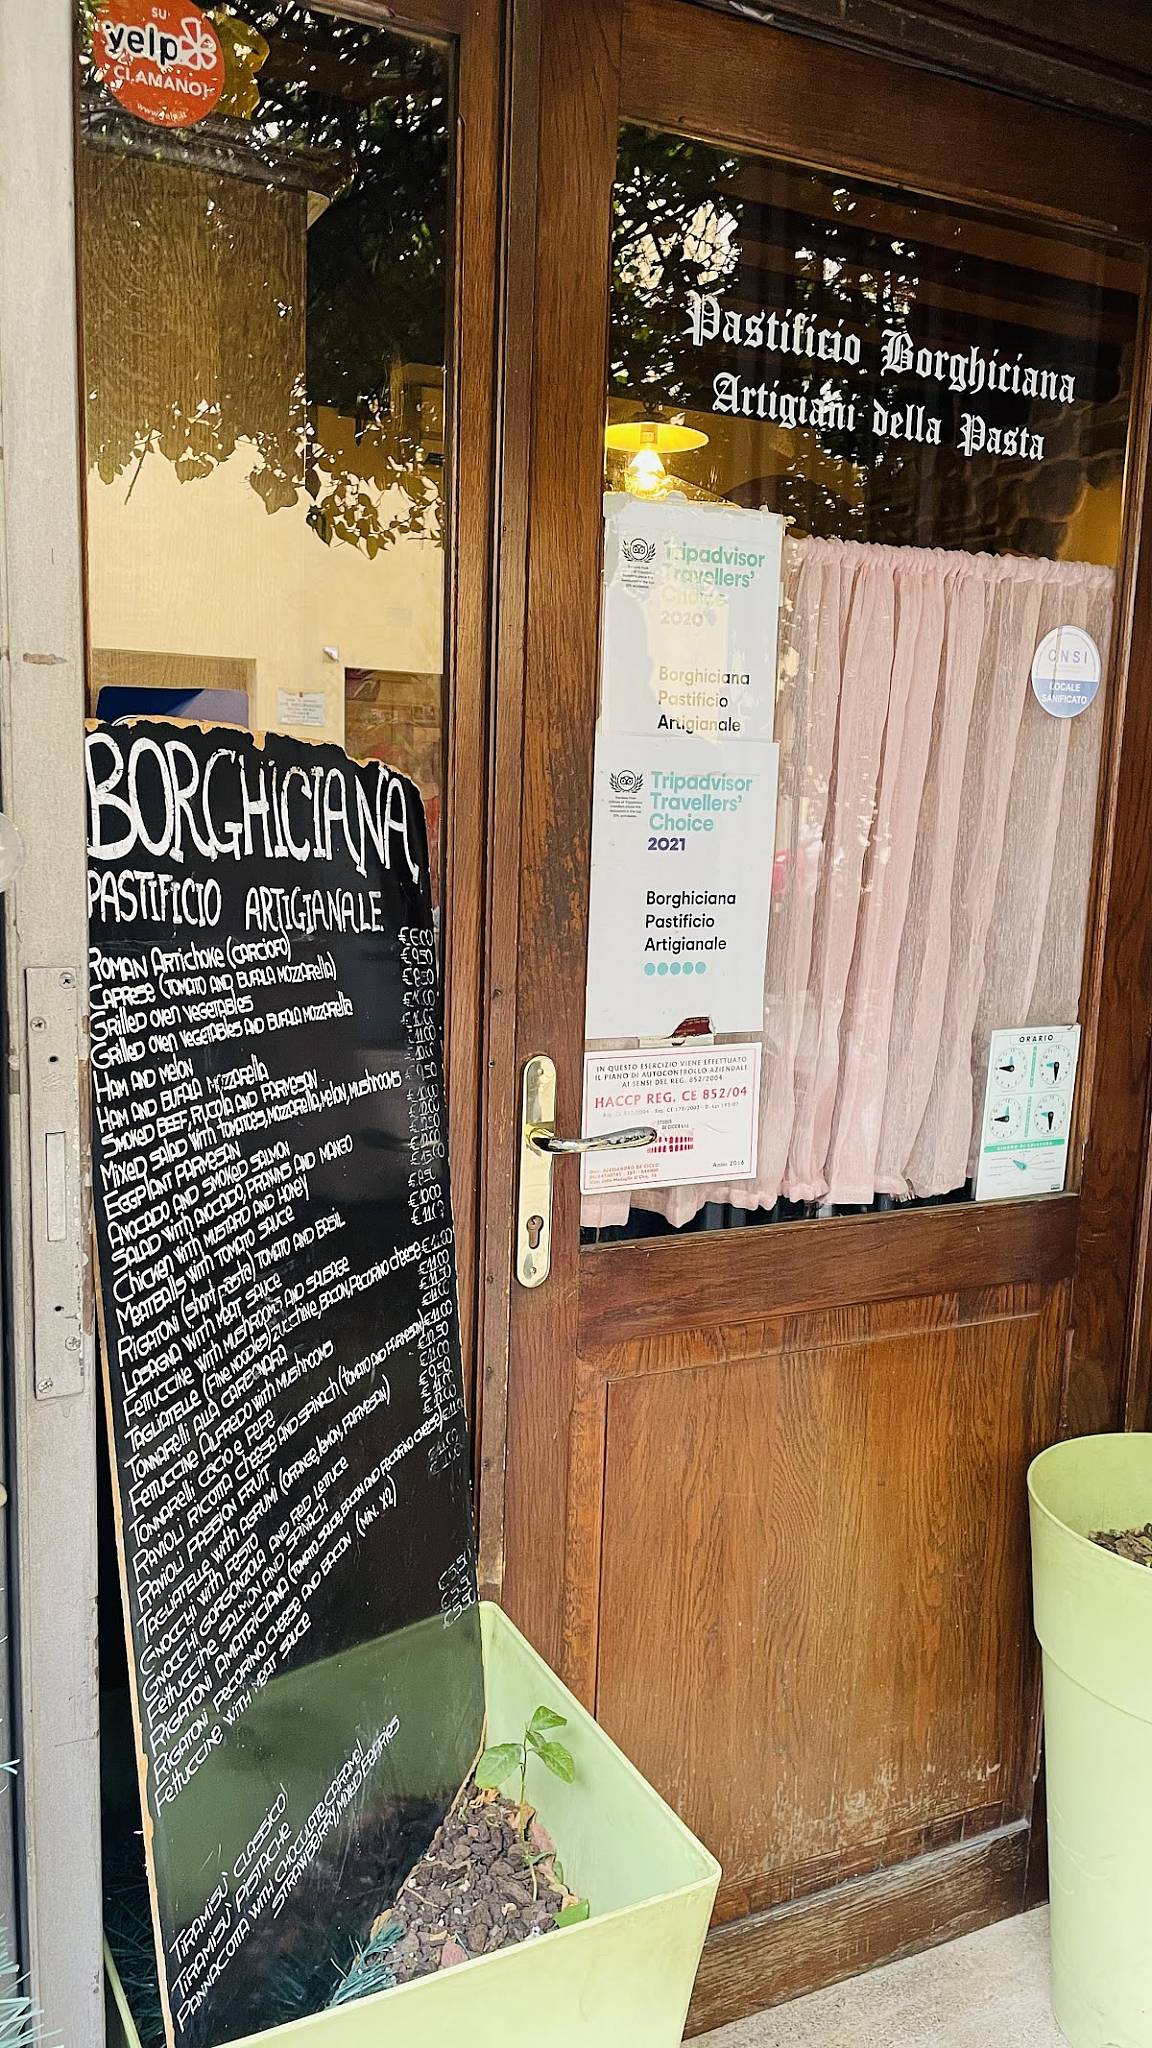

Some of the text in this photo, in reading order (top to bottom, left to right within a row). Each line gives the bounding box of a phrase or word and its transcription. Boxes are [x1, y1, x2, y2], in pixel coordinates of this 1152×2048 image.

[104, 23, 178, 65] yelp
[684, 289, 1076, 405] Pastificio Borghiciana
[712, 371, 1045, 462] Artigiani della Pasta
[660, 610, 704, 627] 2020
[658, 666, 751, 686] Borghiciana
[1050, 682, 1081, 692] LOCALE
[658, 690, 729, 708] Pastificio
[657, 714, 741, 734] Artigianale
[650, 770, 753, 794] Tripadvisor
[84, 732, 419, 885] BORGHICIANA
[648, 813, 714, 832] Choice
[647, 836, 686, 852] 2021
[88, 870, 385, 935] PASTIFICIO ARTIGIANALE
[646, 890, 737, 909] Borghiciana
[645, 913, 715, 929] Pastificio
[644, 936, 727, 955] Artigianale
[89, 947, 148, 981] ROMAN
[159, 972, 207, 999] (TOMATO
[209, 973, 234, 994] AND
[236, 966, 276, 989] BUFALA
[244, 1006, 302, 1035] AND BUFALA
[1019, 1035, 1054, 1043] ORARIO
[595, 1064, 748, 1081] IL PIANO DI AUTOCONTROLLO AZIENDALE
[596, 1056, 748, 1073] IN QUESTO ESERCIZIO VIENE EFFETTUATO
[621, 1080, 630, 1088] AI
[632, 1078, 652, 1087] SENSI
[655, 1077, 668, 1086] DEL
[689, 1074, 723, 1083] 852/2004
[92, 1069, 156, 1104] HAM AND
[235, 1091, 258, 1113] AND
[594, 1086, 747, 1109] HACCP REG. CE 852/04
[96, 1077, 203, 1134] HAM AND BUFALA
[108, 1141, 291, 1249] AVOCADO AND SALMON
[112, 1234, 162, 1275] SALAD
[245, 1162, 292, 1200] PRAWNS
[293, 1151, 316, 1175] AND
[319, 1134, 353, 1164] MANGO
[203, 1193, 275, 1248] MUSTARD AND
[214, 1229, 255, 1267] TOMATO
[254, 1237, 290, 1269] TOMATO
[293, 1227, 315, 1251] AND
[284, 1282, 304, 1308] AND
[122, 1342, 183, 1396] LASAGNA
[193, 1400, 220, 1436] ALLA
[198, 1448, 233, 1488] CACIO
[364, 1467, 380, 1492] AND
[132, 1517, 185, 1584] RAVIOLI
[187, 1473, 233, 1529] RICOTTA
[277, 1416, 298, 1446] AND
[137, 1463, 271, 1613] RAVIOLI PASSION FRUIT
[200, 1549, 266, 1637] GORGONZOLA
[269, 1521, 290, 1553] AND
[218, 1498, 329, 1642] SALMON AND SPINACH
[301, 1571, 322, 1602] AND
[320, 1531, 352, 1576] BACON
[177, 1917, 251, 2033] PANNACOTTA
